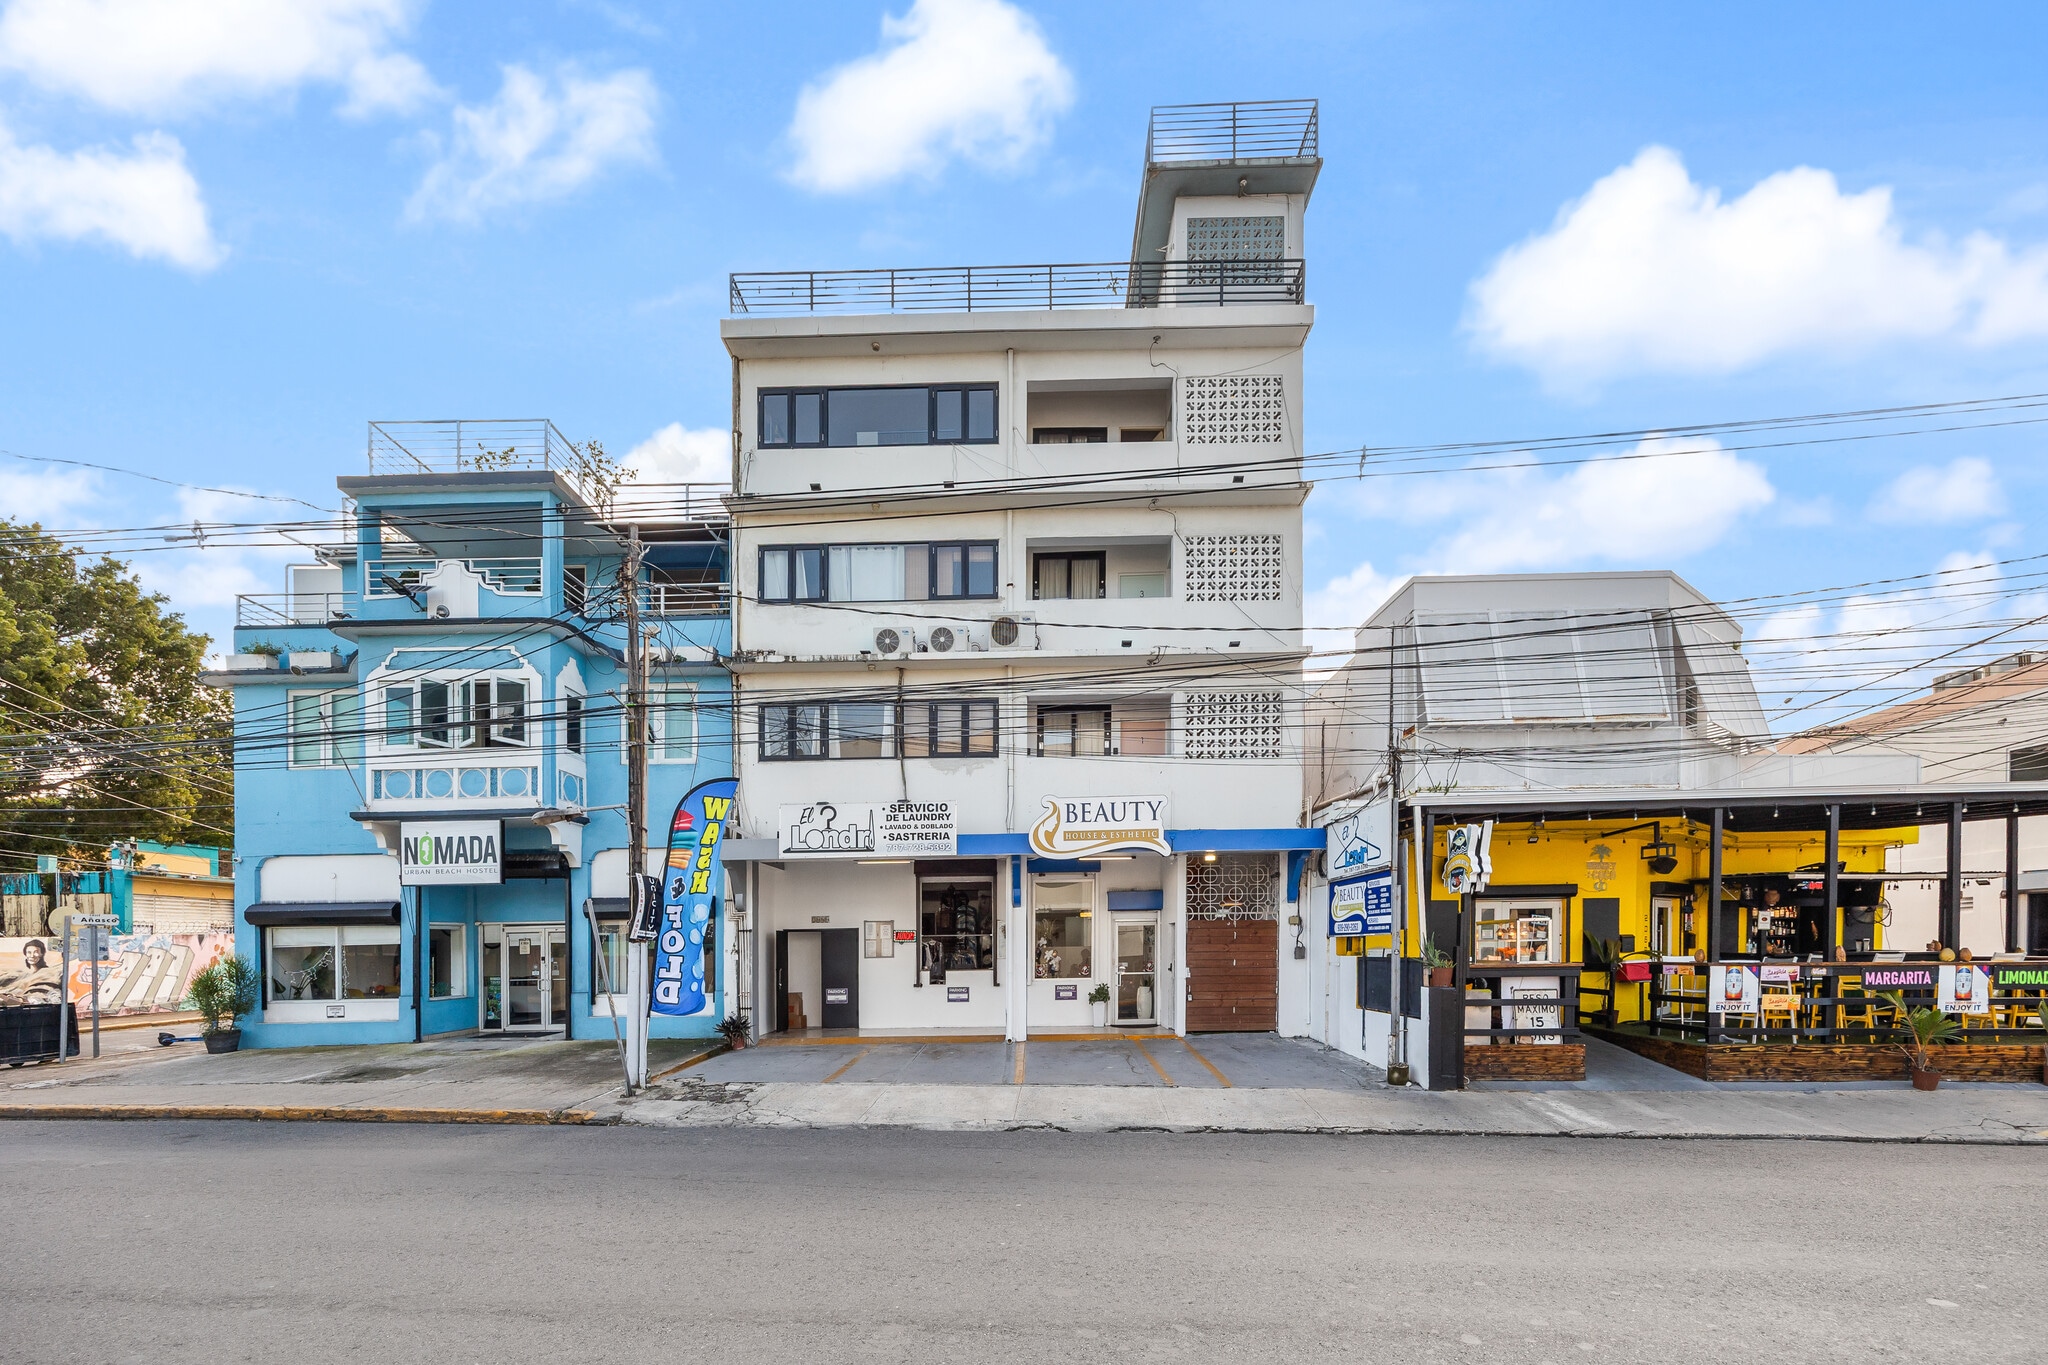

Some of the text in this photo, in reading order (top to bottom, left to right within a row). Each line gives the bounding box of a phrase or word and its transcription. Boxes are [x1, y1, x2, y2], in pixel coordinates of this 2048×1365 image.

[890, 803, 948, 813] SERVICIO
[1065, 801, 1163, 823] BEAUTY
[886, 813, 951, 822] DE LAUNDRY
[888, 832, 950, 841] SASTRERIA
[1065, 830, 1158, 840] HOUSE & ESTHETIC
[886, 843, 952, 853] 787-728-5392
[1339, 886, 1366, 902] BEAUTY
[81, 915, 117, 923] Añasco
[1865, 971, 1932, 985] MARGARITA
[1530, 1017, 1544, 1028] 15
